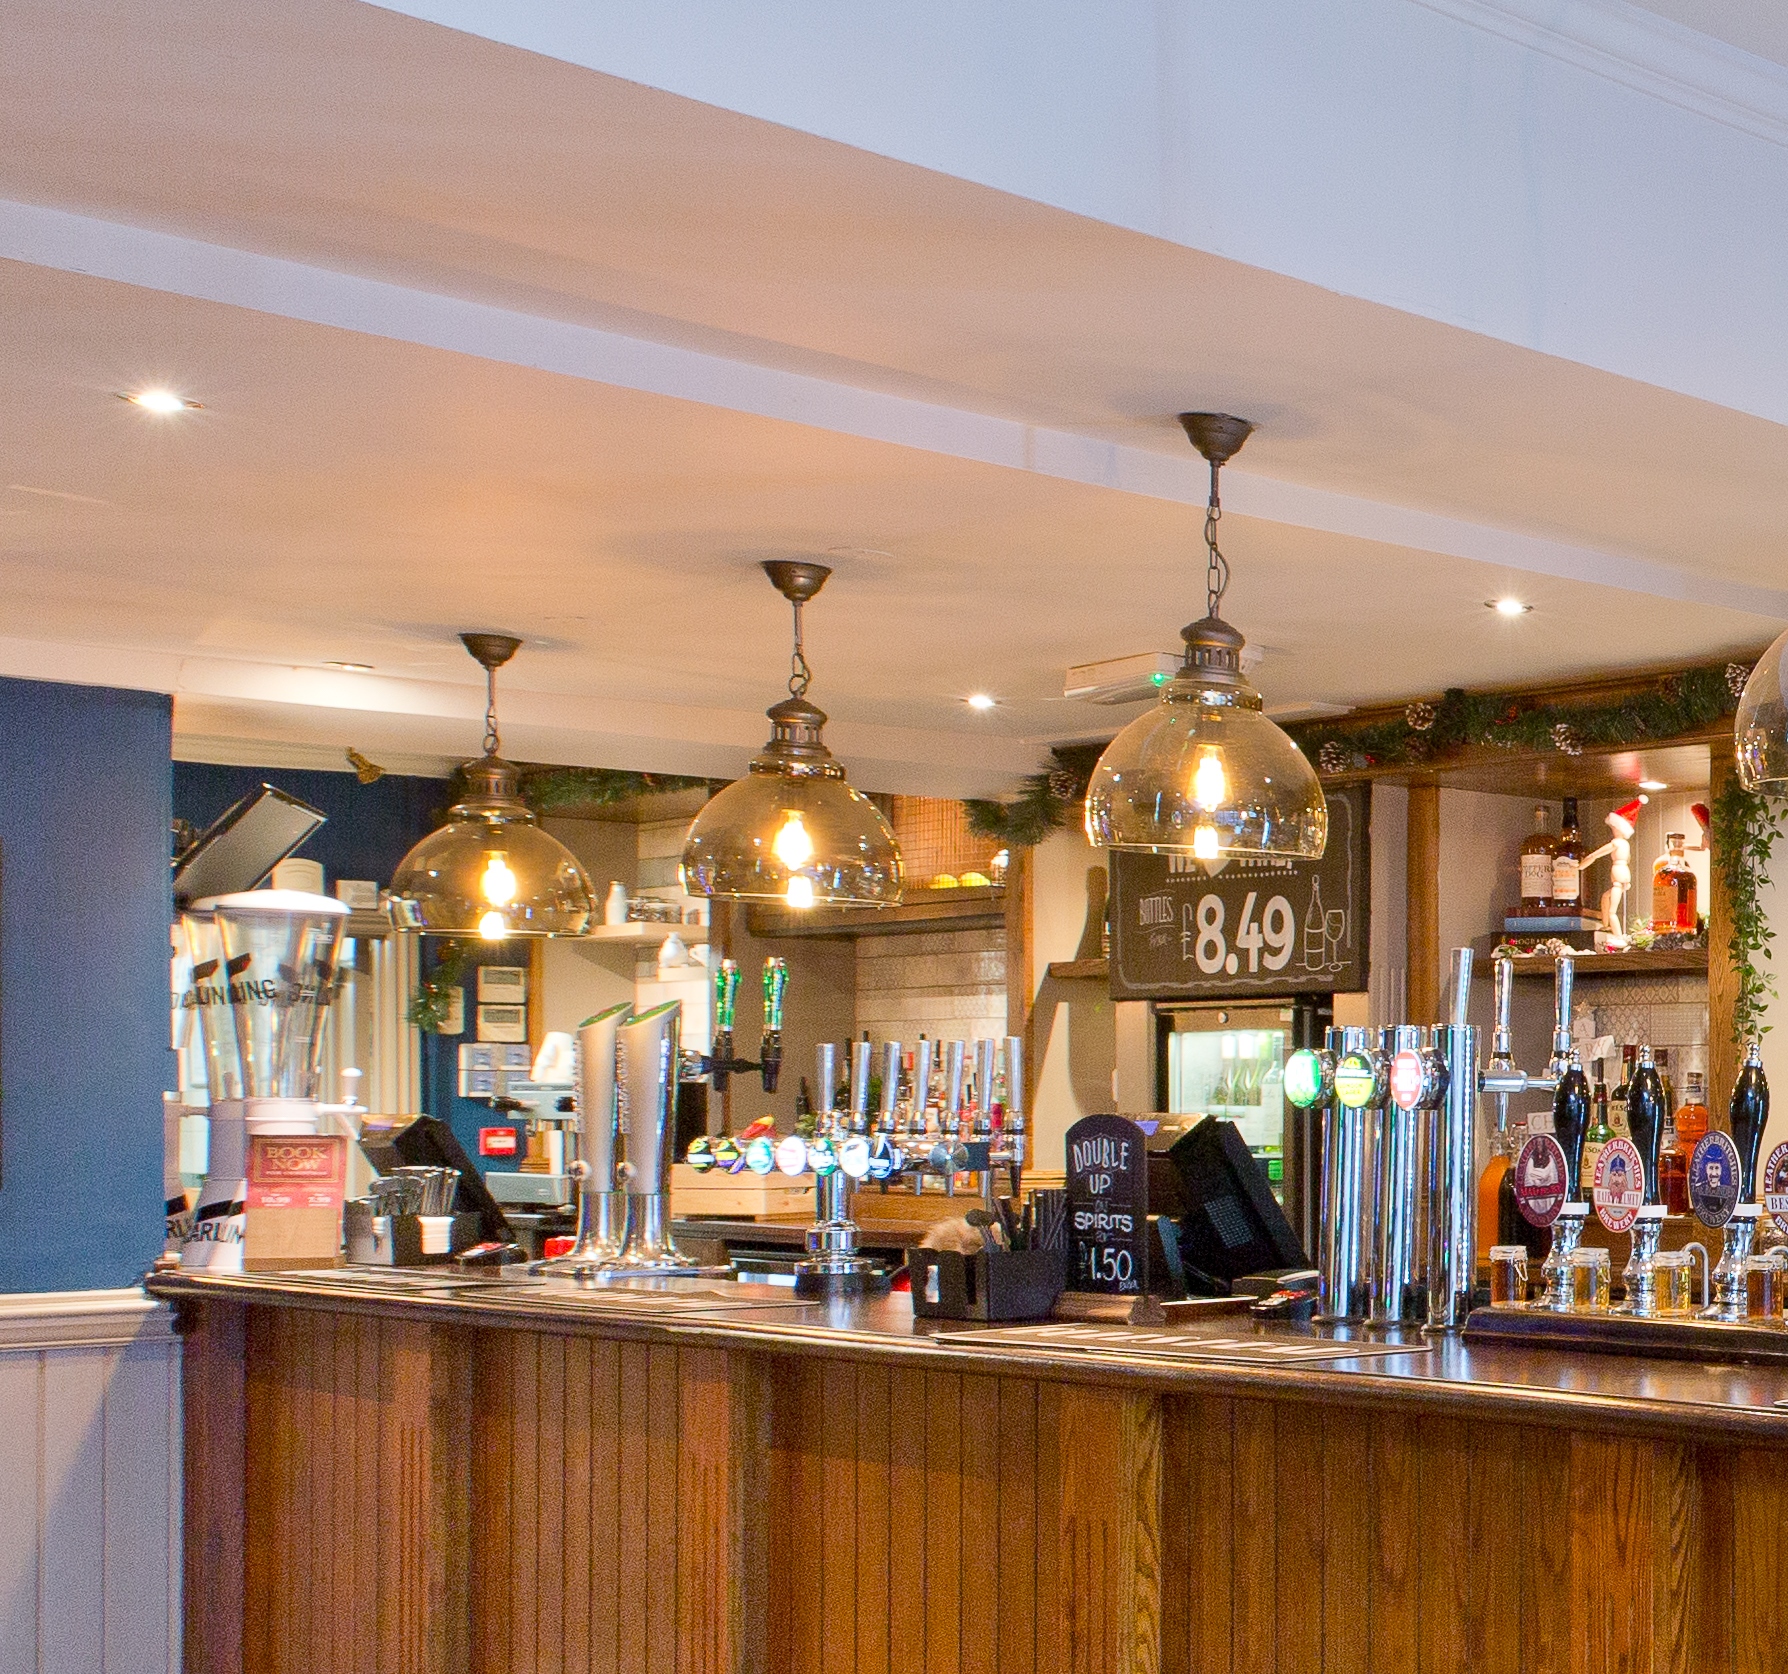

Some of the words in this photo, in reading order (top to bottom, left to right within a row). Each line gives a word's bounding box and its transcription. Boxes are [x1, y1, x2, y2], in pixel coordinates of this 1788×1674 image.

[1139, 896, 1174, 926] BOTTLES
[1181, 892, 1295, 975] £8.49
[266, 1146, 328, 1159] BOOK
[271, 1158, 321, 1170] NOW
[1073, 1138, 1129, 1173] DOUBLE
[1594, 1139, 1642, 1189] LEATHERBRITCHES
[1089, 1174, 1112, 1195] UP
[1074, 1211, 1133, 1232] SPIRITS
[1599, 1207, 1634, 1230] BREWERY
